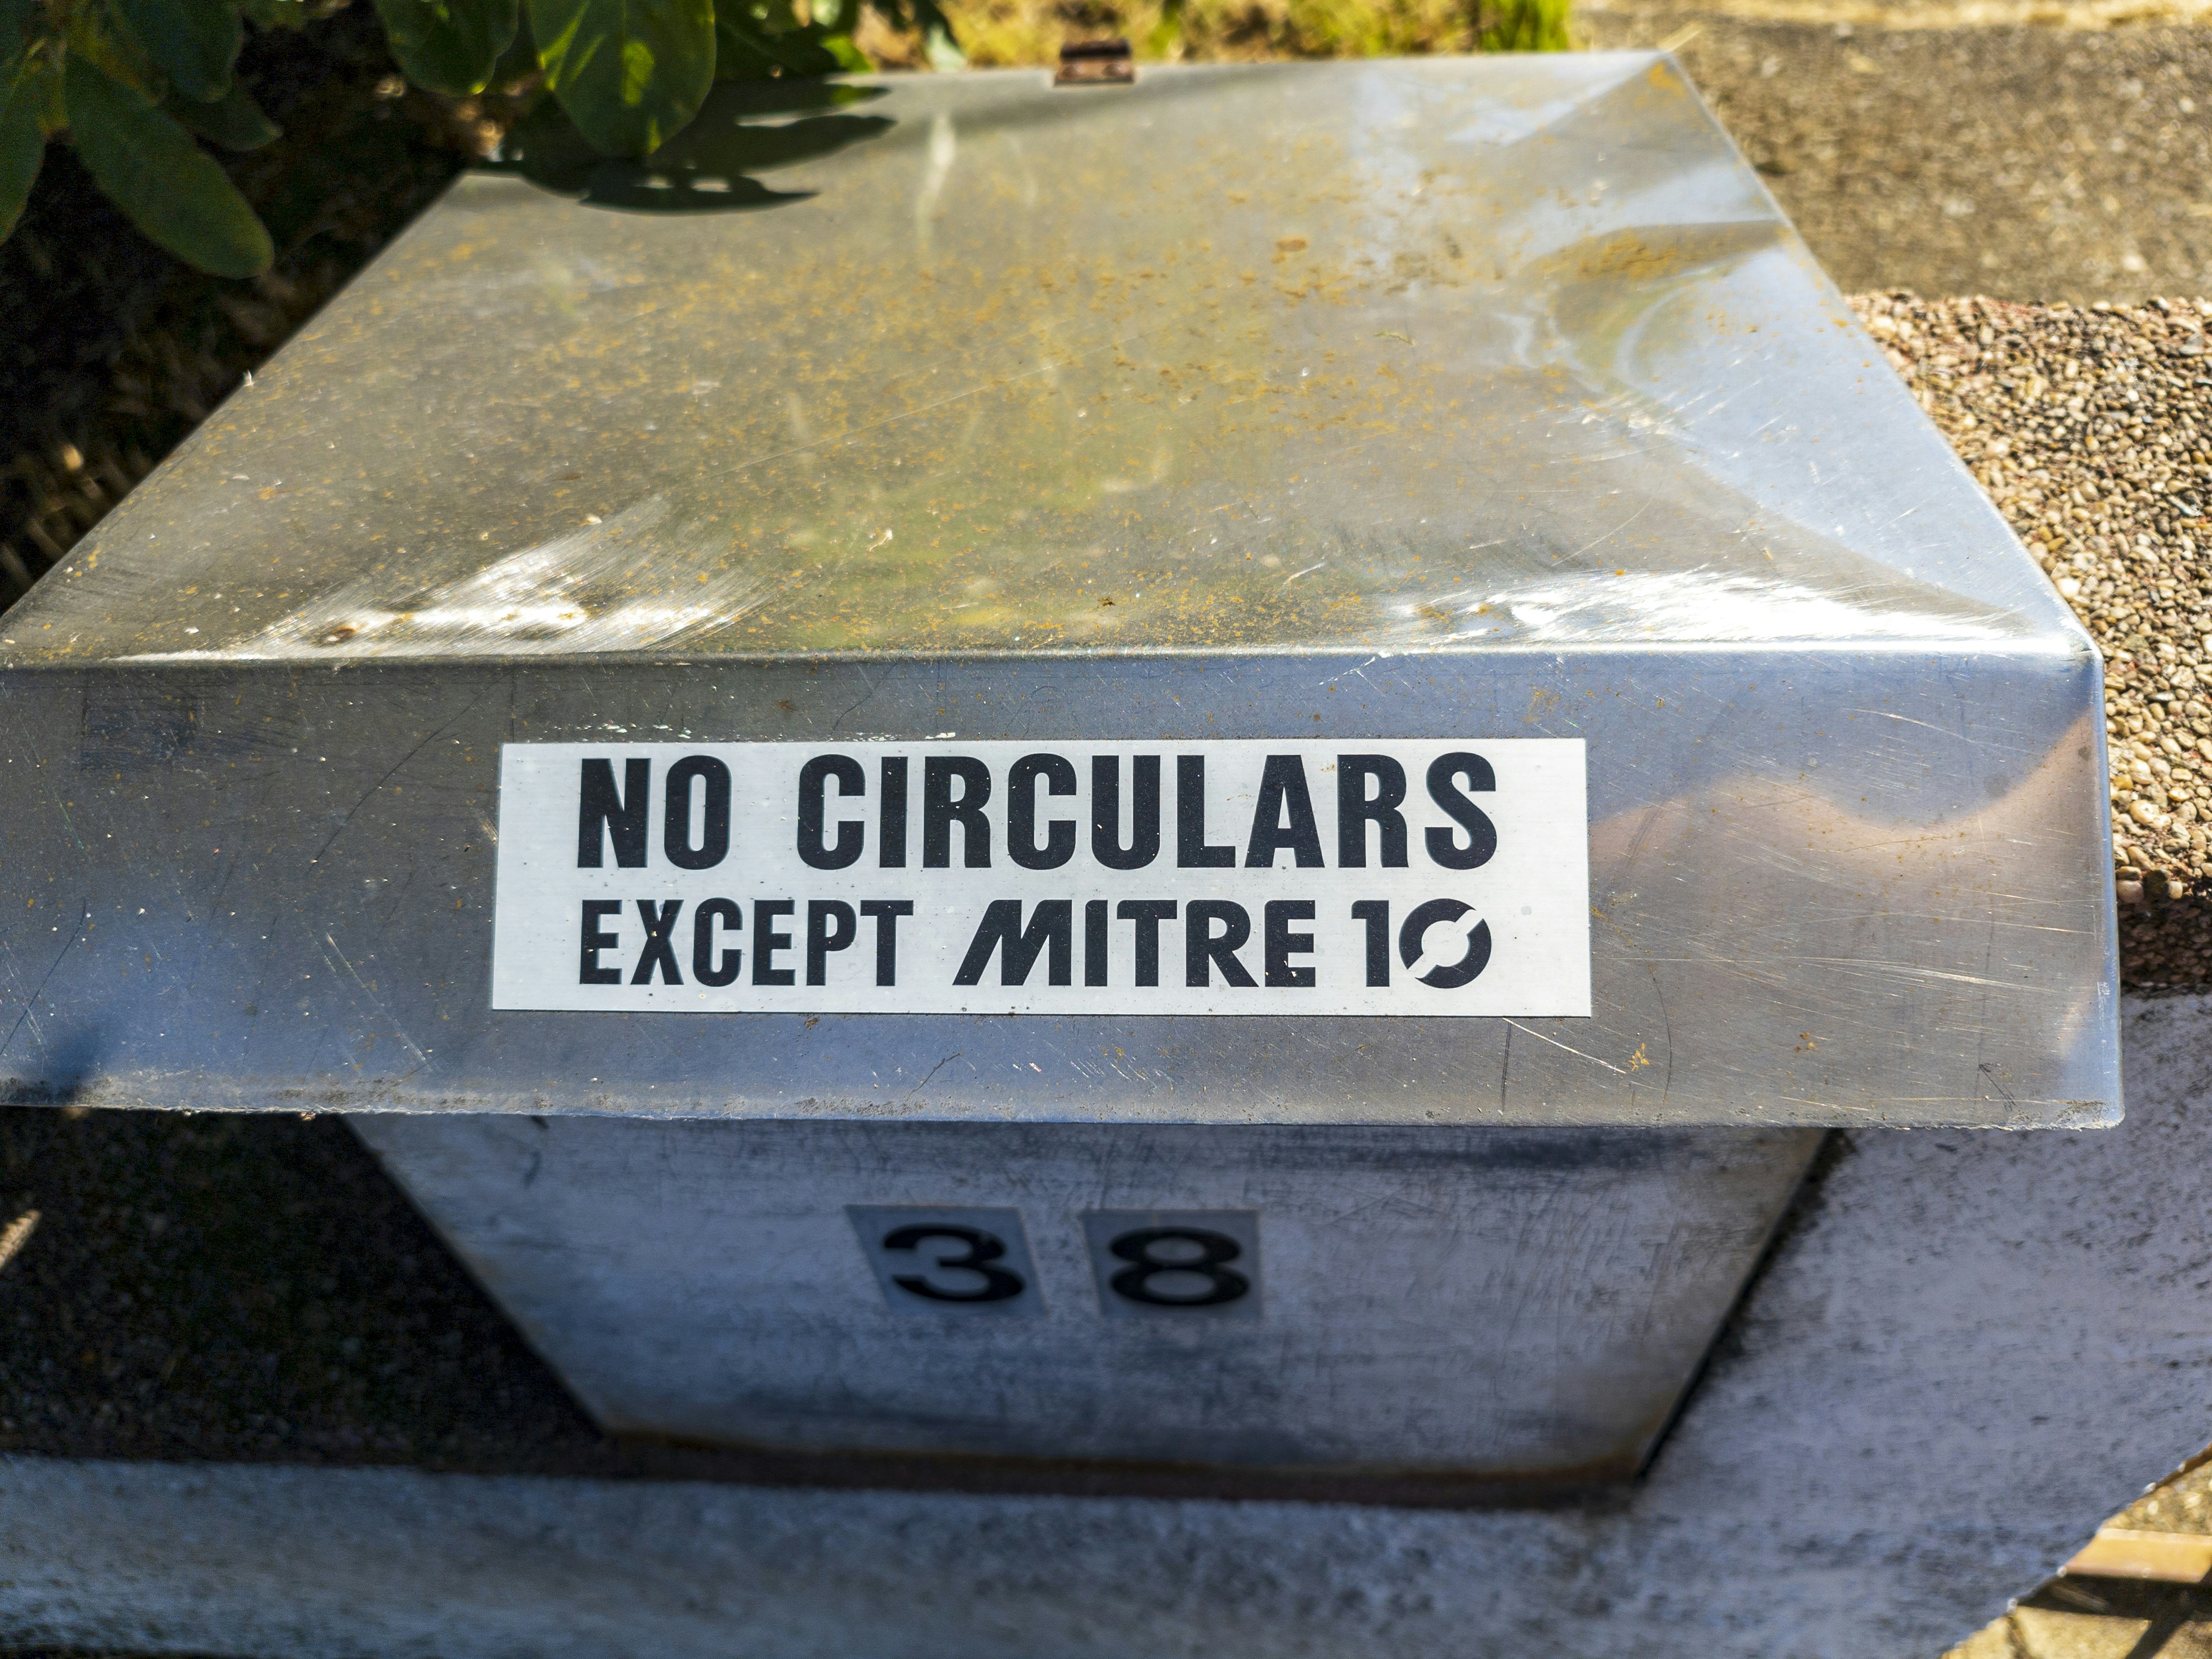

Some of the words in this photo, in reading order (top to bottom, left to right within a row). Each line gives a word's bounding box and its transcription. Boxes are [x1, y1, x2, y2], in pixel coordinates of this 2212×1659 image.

[577, 755, 731, 870] NO
[797, 753, 1496, 870] CIRCULARS
[579, 898, 914, 987] EXCEPT
[952, 900, 1316, 988] MITRE
[1352, 899, 1492, 989] 10
